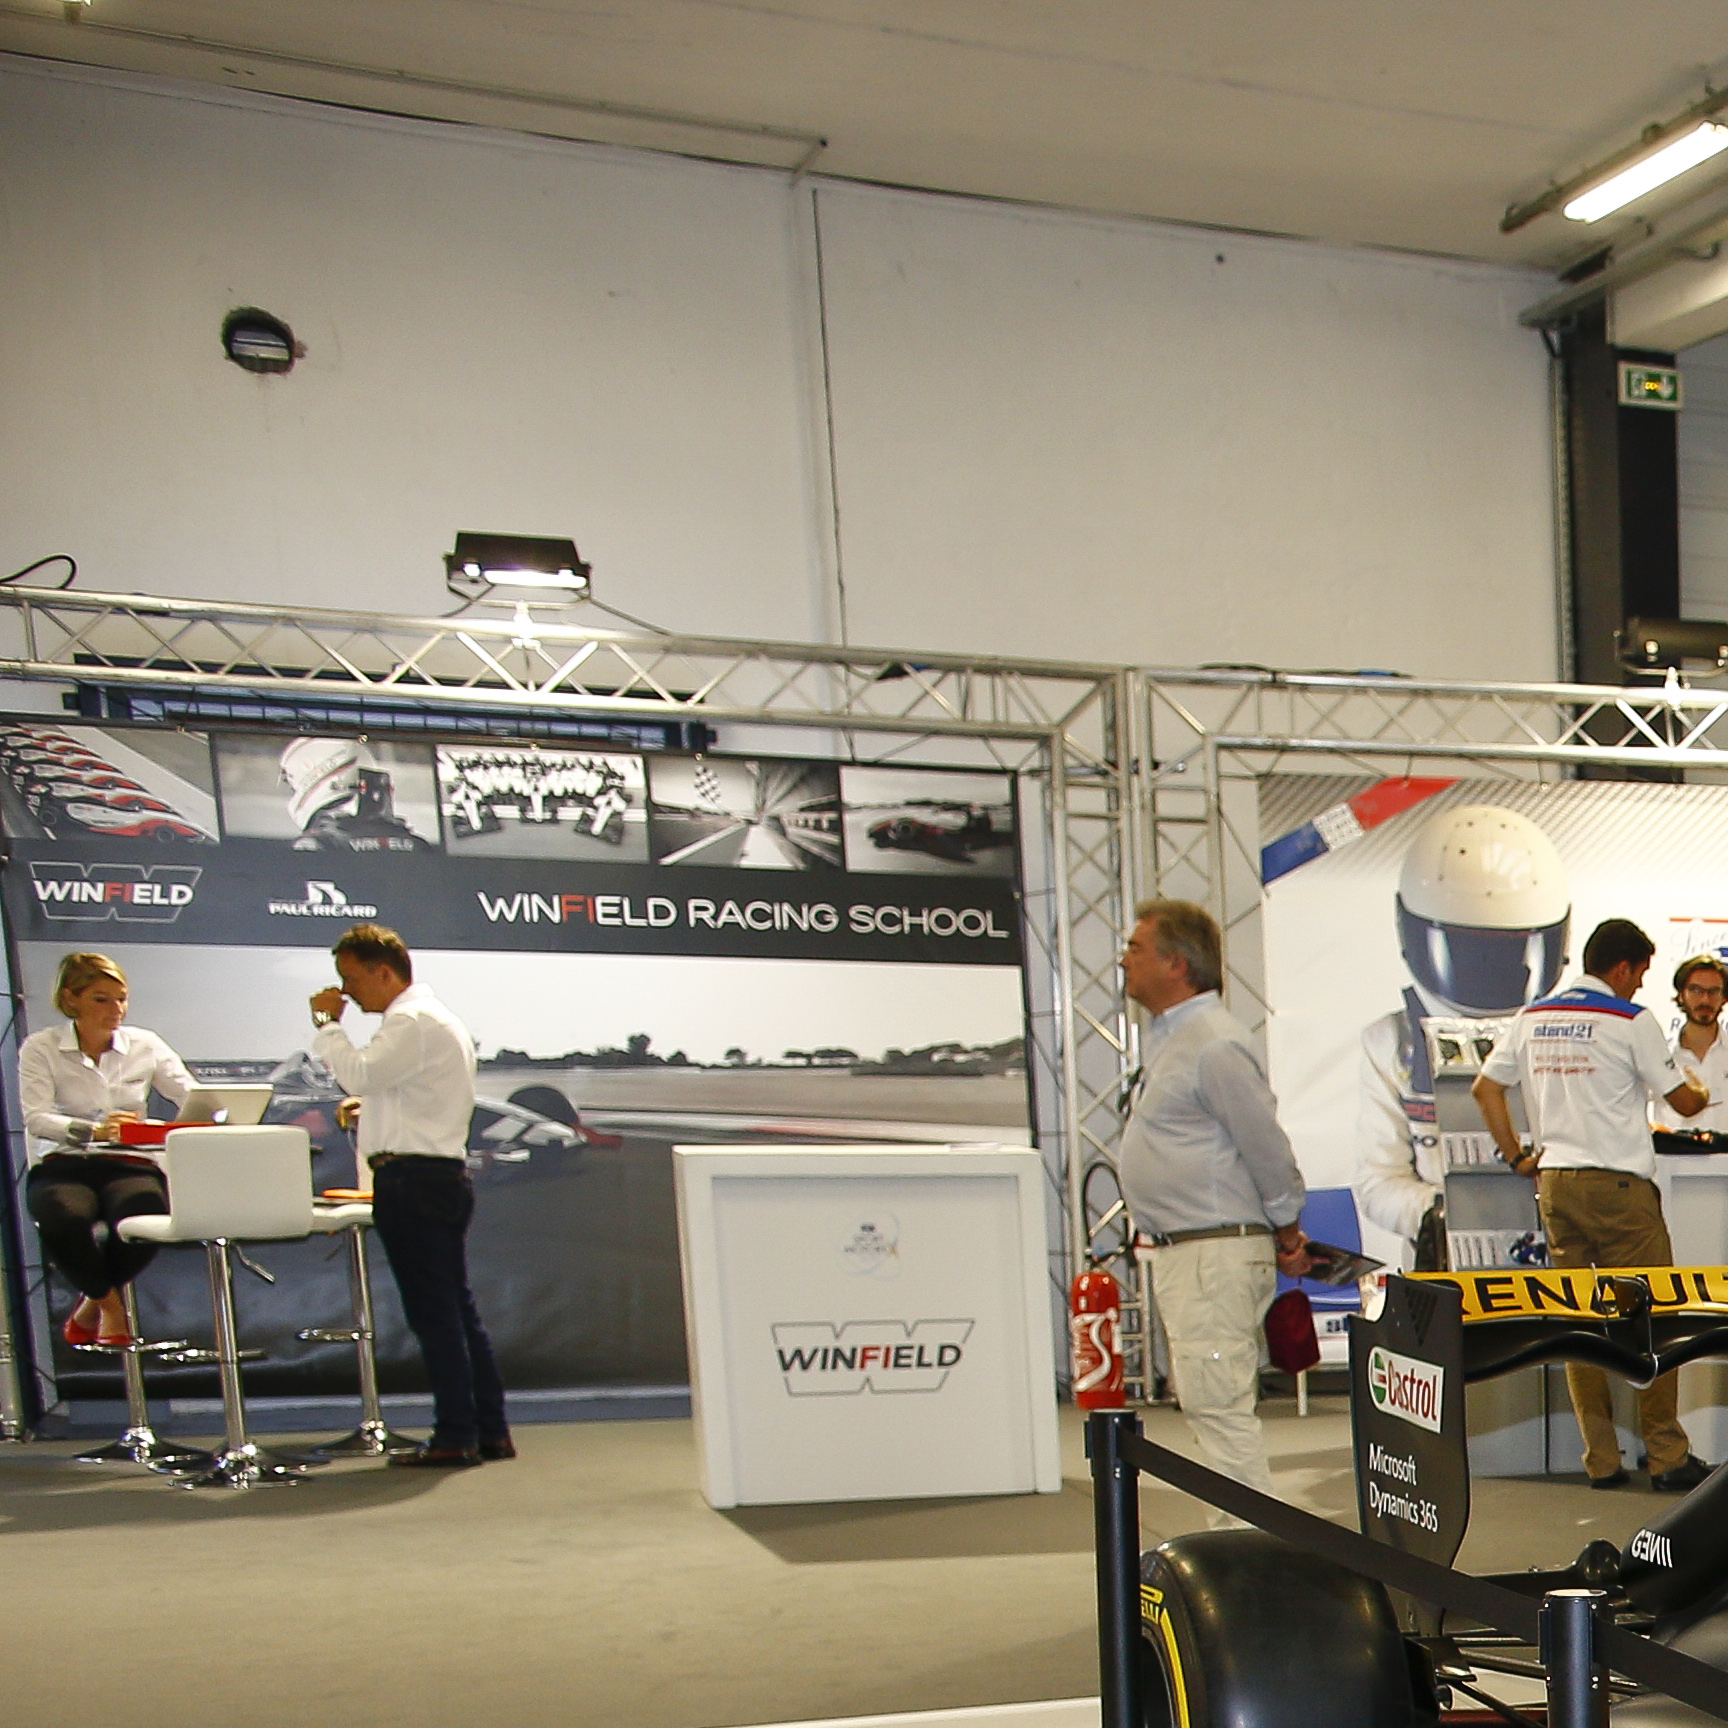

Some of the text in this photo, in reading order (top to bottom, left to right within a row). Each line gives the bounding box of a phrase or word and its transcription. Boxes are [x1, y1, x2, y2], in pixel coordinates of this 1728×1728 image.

[33, 880, 194, 906] WINFIELD
[477, 891, 1010, 939] WINFIELD RACING SCHOOL
[777, 1345, 962, 1371] WINFIELD
[1387, 1358, 1438, 1422] Castrol
[1368, 1443, 1417, 1487] Microsoft
[1368, 1481, 1438, 1534] Dynamics 365
